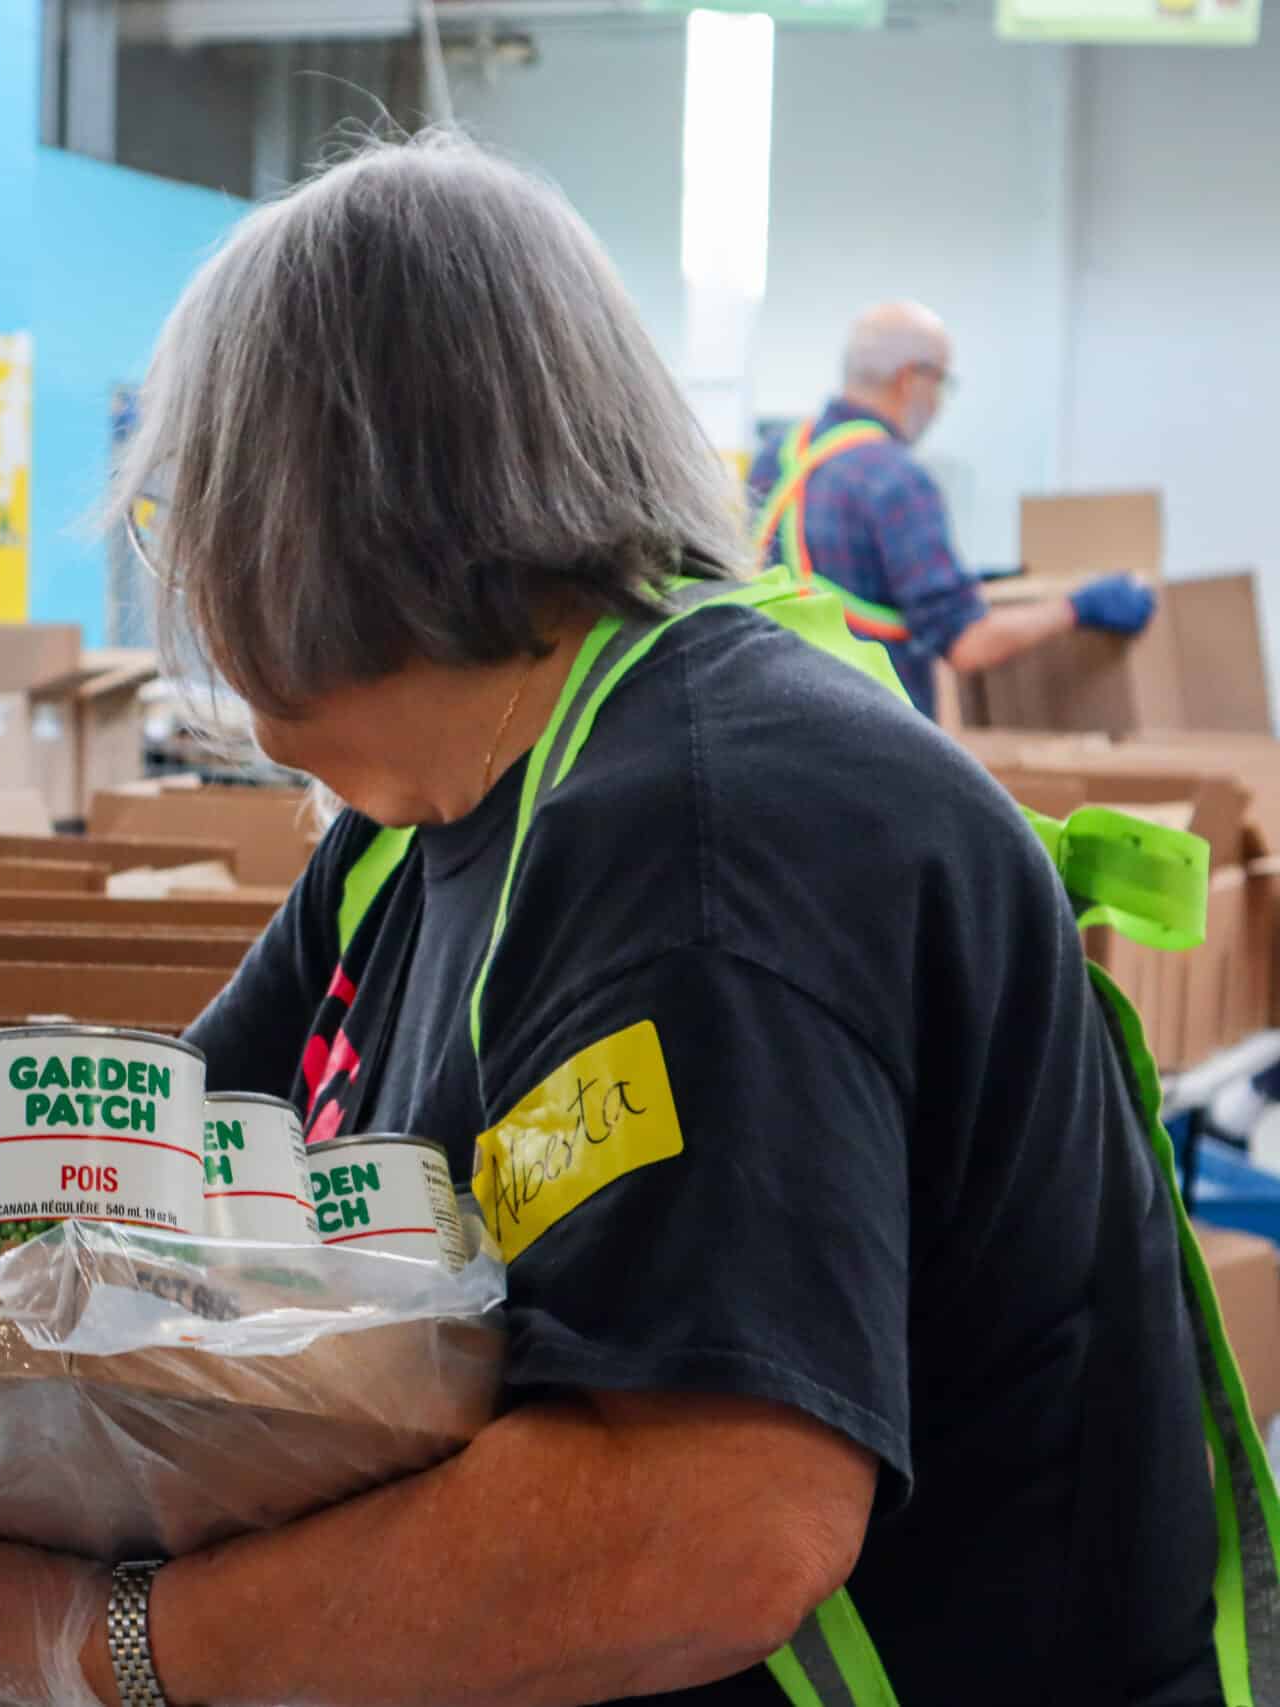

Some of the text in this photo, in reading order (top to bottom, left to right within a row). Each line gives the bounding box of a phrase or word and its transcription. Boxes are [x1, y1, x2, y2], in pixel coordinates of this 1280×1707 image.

[8, 1056, 171, 1099] GARDEN
[25, 1093, 156, 1133] PATCH
[60, 1164, 119, 1194] POIS
[491, 1077, 647, 1243] Alberta
[310, 1161, 381, 1202] DEN
[105, 1202, 126, 1216] 540
[145, 1206, 156, 1219] 19
